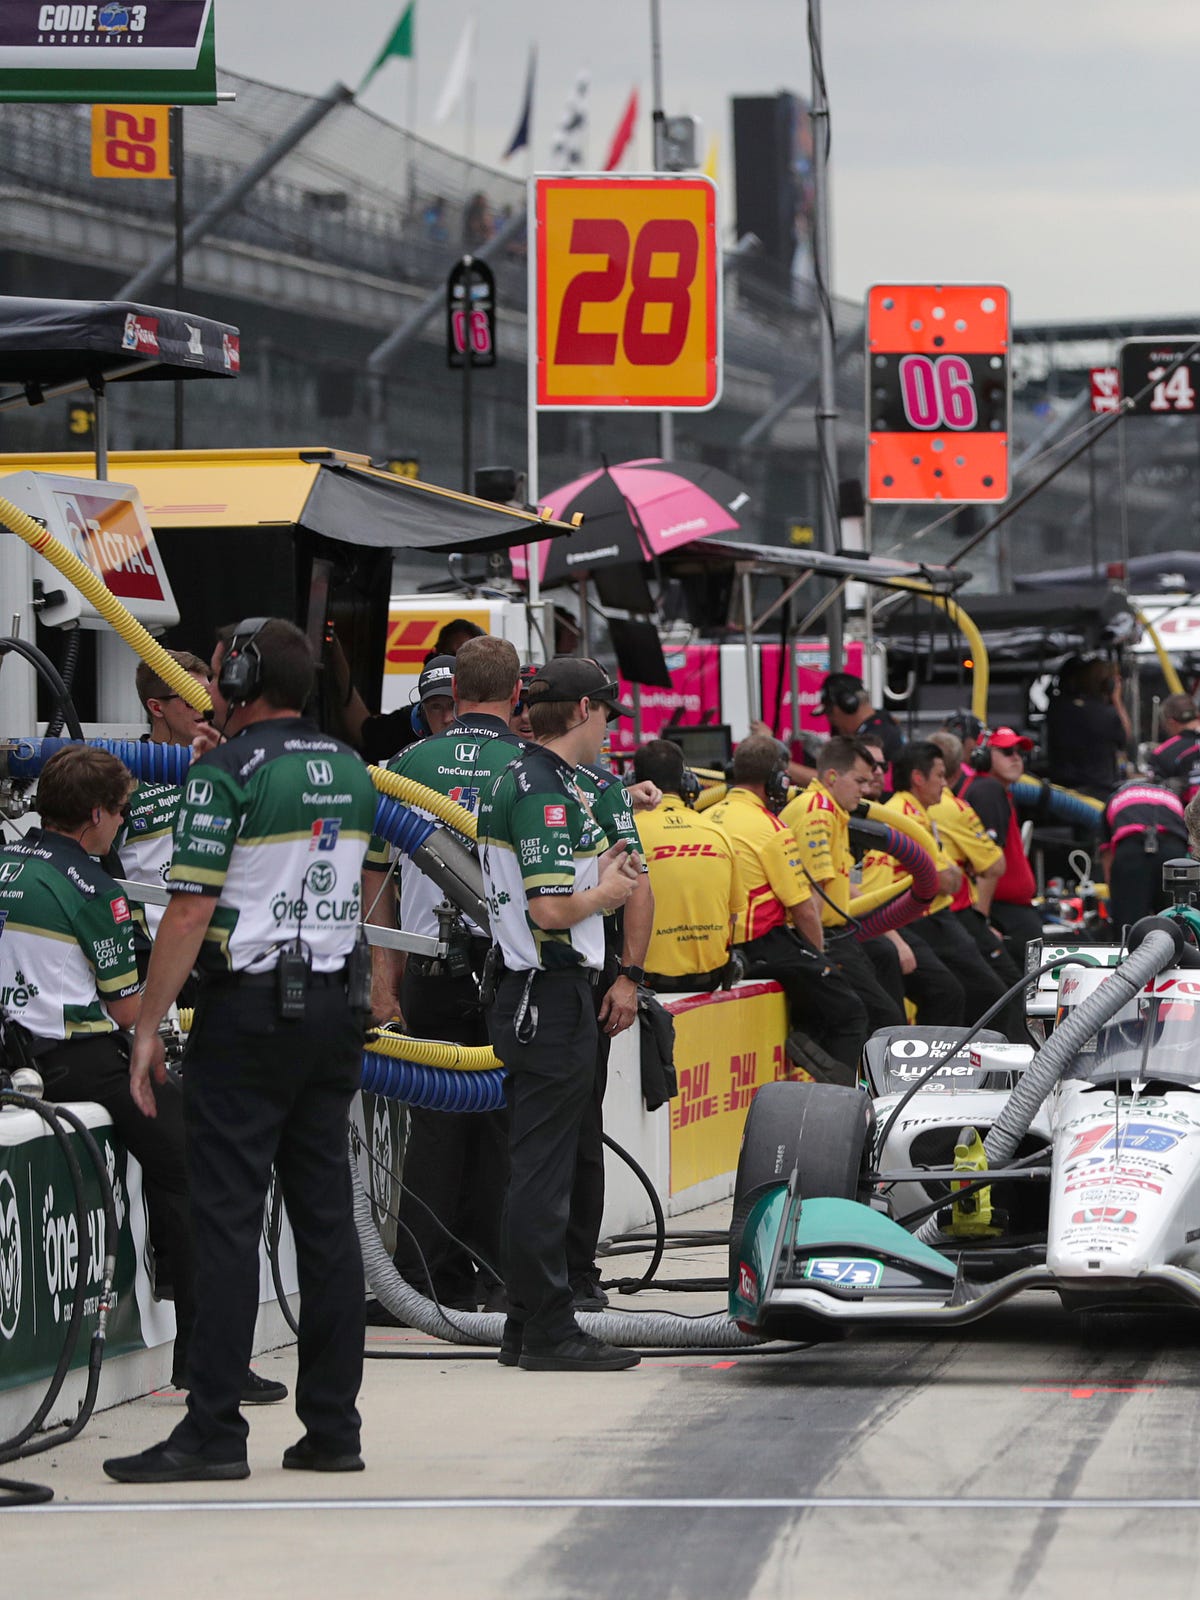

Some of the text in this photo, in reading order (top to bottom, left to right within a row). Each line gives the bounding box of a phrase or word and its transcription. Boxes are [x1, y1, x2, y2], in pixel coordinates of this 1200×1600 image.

[38, 5, 147, 31] CODE 3
[37, 35, 144, 43] ASSOCIATES
[105, 109, 156, 174] 28
[553, 218, 700, 366] 28
[899, 354, 978, 431] 06
[1147, 366, 1196, 410] 14
[85, 518, 155, 576] TOTAL
[620, 692, 701, 711] AtoNation
[437, 765, 491, 777] OneCure.com
[309, 817, 342, 852] 15
[520, 838, 540, 848] FLEET
[521, 847, 540, 857] COST
[522, 855, 542, 866] CARE
[652, 844, 718, 861] DHL
[540, 885, 574, 895] OneCure.c
[93, 936, 115, 951] FLEET
[96, 946, 117, 961] COST
[98, 955, 119, 970] CARE
[1063, 1122, 1188, 1164] 15
[45, 1212, 79, 1296] one
